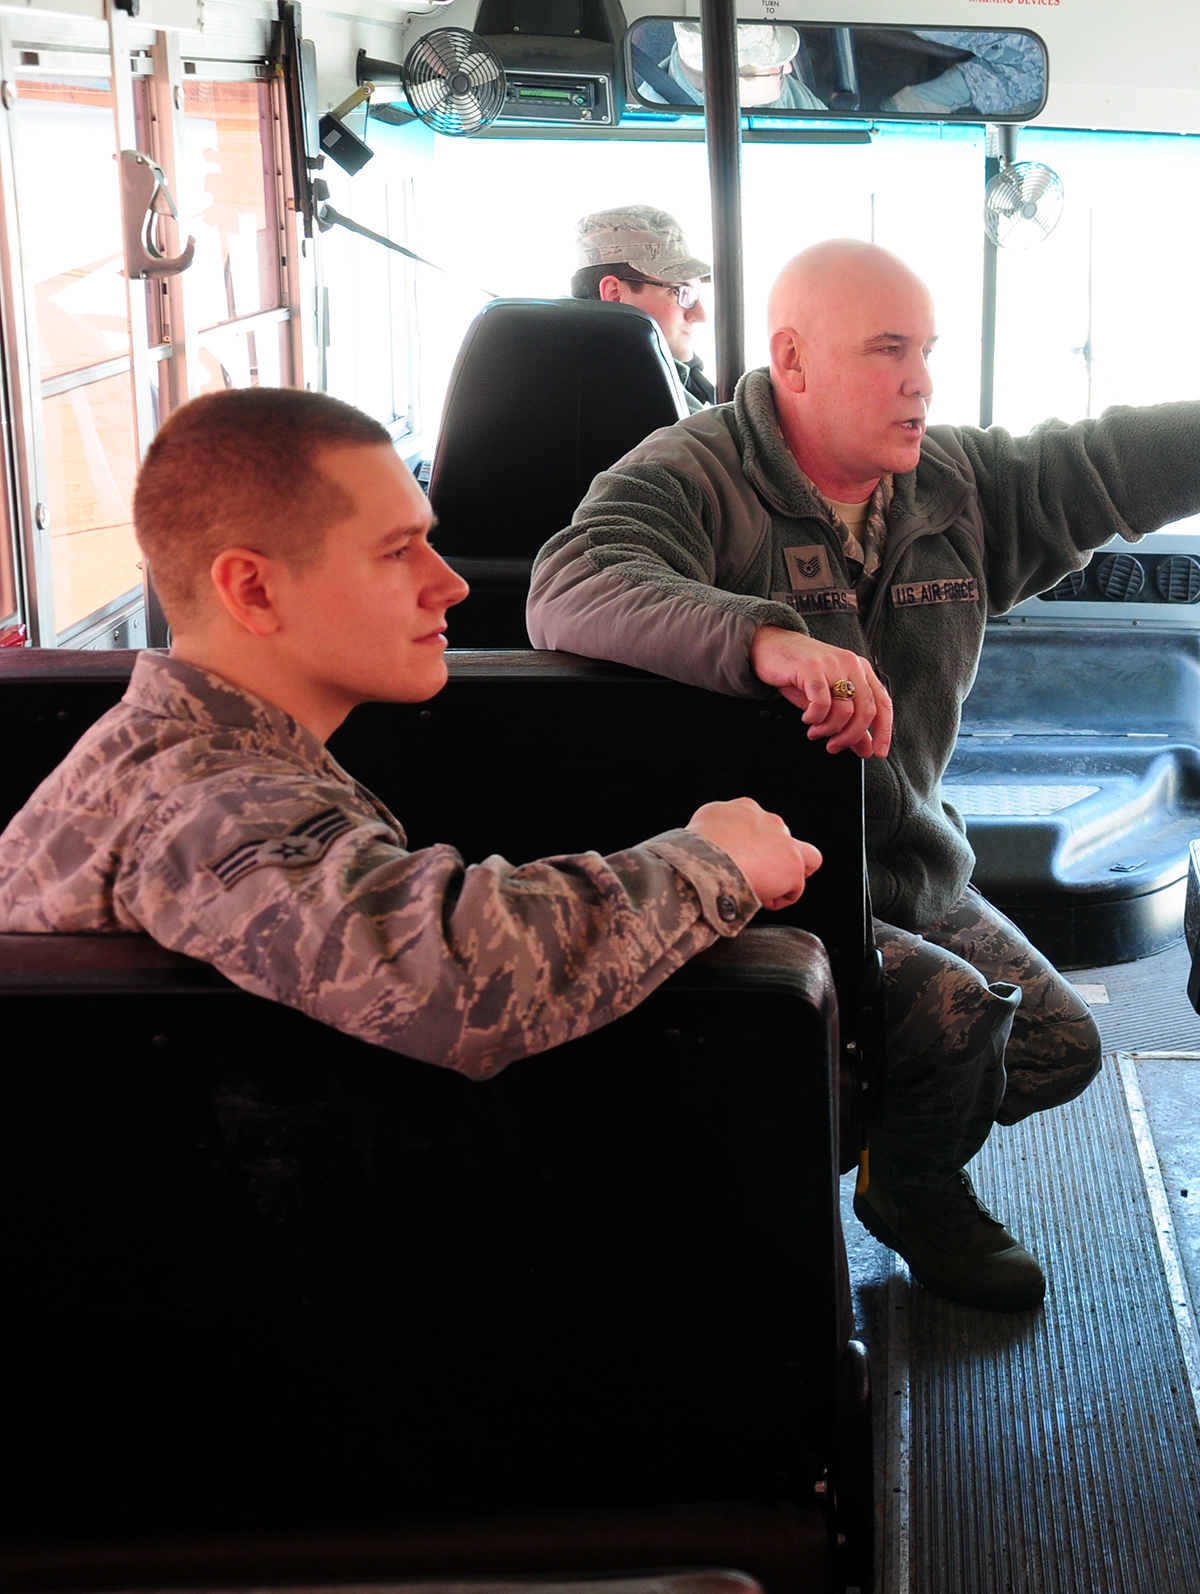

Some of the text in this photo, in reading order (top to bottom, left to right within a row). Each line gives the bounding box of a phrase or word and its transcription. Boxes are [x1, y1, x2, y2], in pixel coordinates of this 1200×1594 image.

[785, 591, 848, 613] SUMMERS
[920, 582, 942, 604] AIR
[943, 580, 975, 601] FORCE
